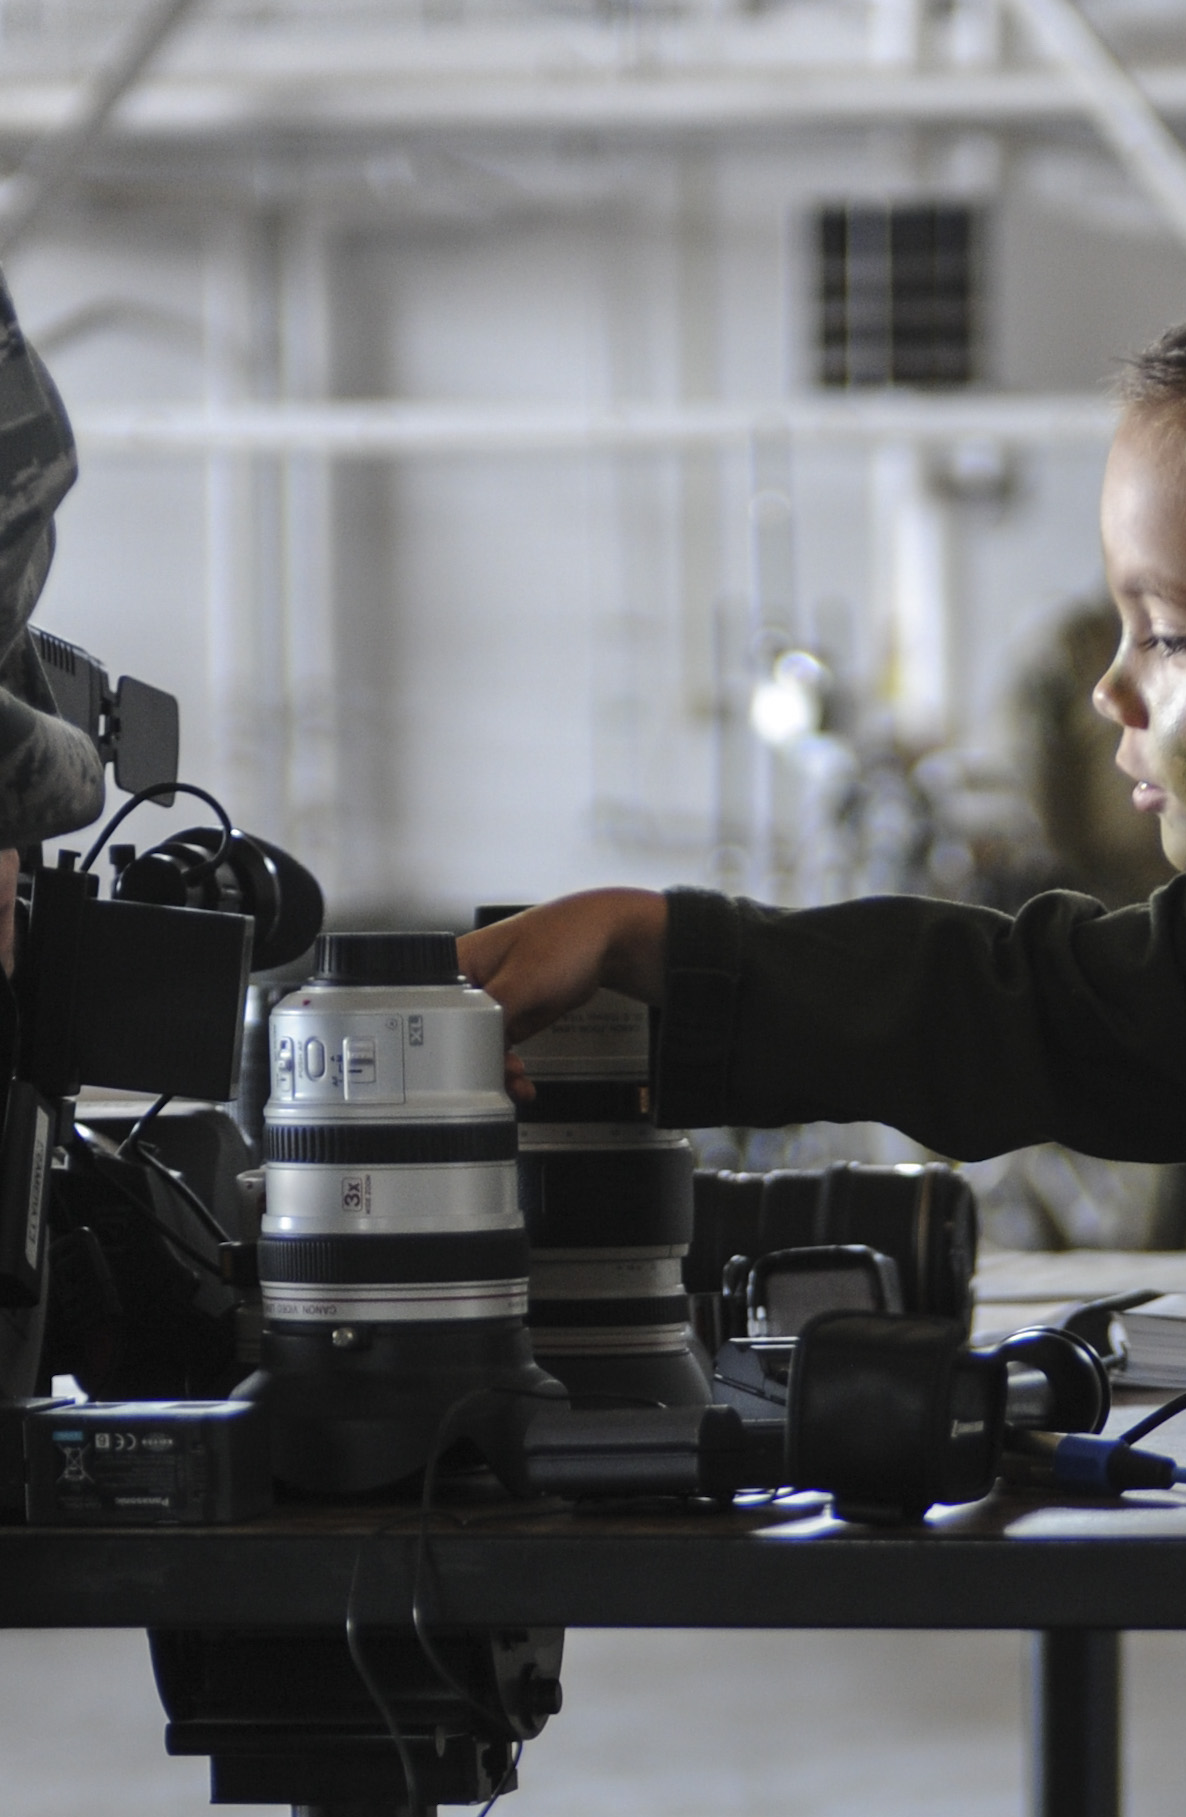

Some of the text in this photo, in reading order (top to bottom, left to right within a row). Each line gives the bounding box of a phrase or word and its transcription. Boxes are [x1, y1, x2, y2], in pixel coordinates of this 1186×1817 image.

[409, 1015, 423, 1044] XL
[343, 1182, 361, 1207] 3x
[302, 1305, 337, 1316] CANON
[115, 1497, 170, 1507] Panasonic
